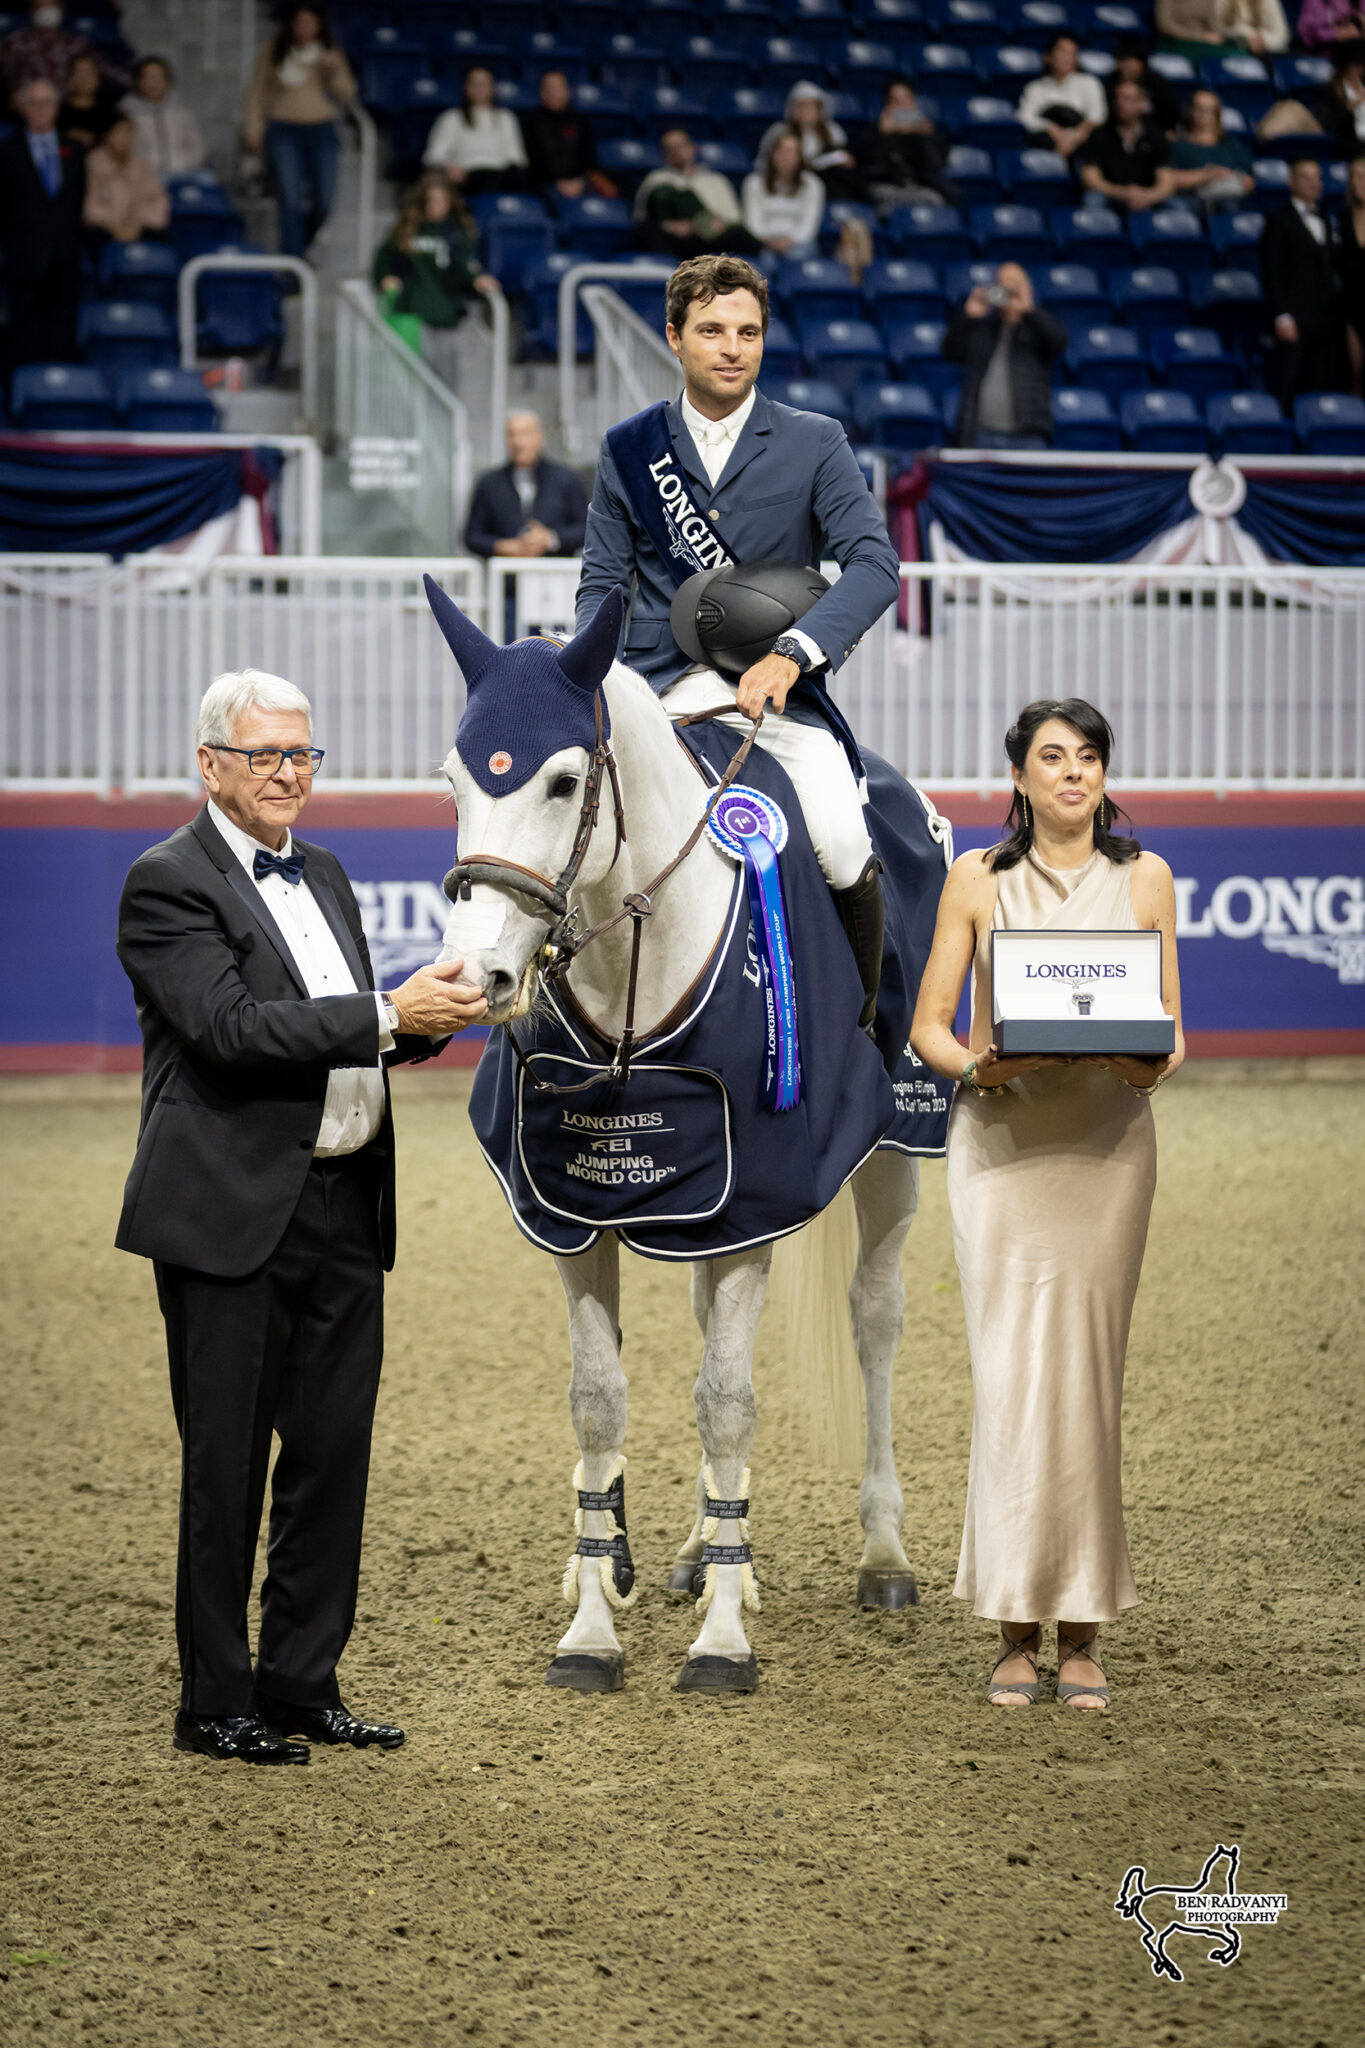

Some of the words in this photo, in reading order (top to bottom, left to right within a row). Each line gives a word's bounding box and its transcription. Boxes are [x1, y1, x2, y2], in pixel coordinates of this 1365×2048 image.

[734, 816, 751, 830] 1st
[1173, 875, 1365, 938] LONG
[776, 932, 785, 966] WORLD
[1025, 964, 1127, 978] LONGINES
[781, 966, 790, 1007] JUMPING
[765, 987, 776, 1056] LONGINES
[562, 1110, 664, 1130] LONGINES
[591, 1138, 632, 1152] FEI
[575, 1152, 654, 1170] JUMPING
[565, 1162, 624, 1184] WORLD
